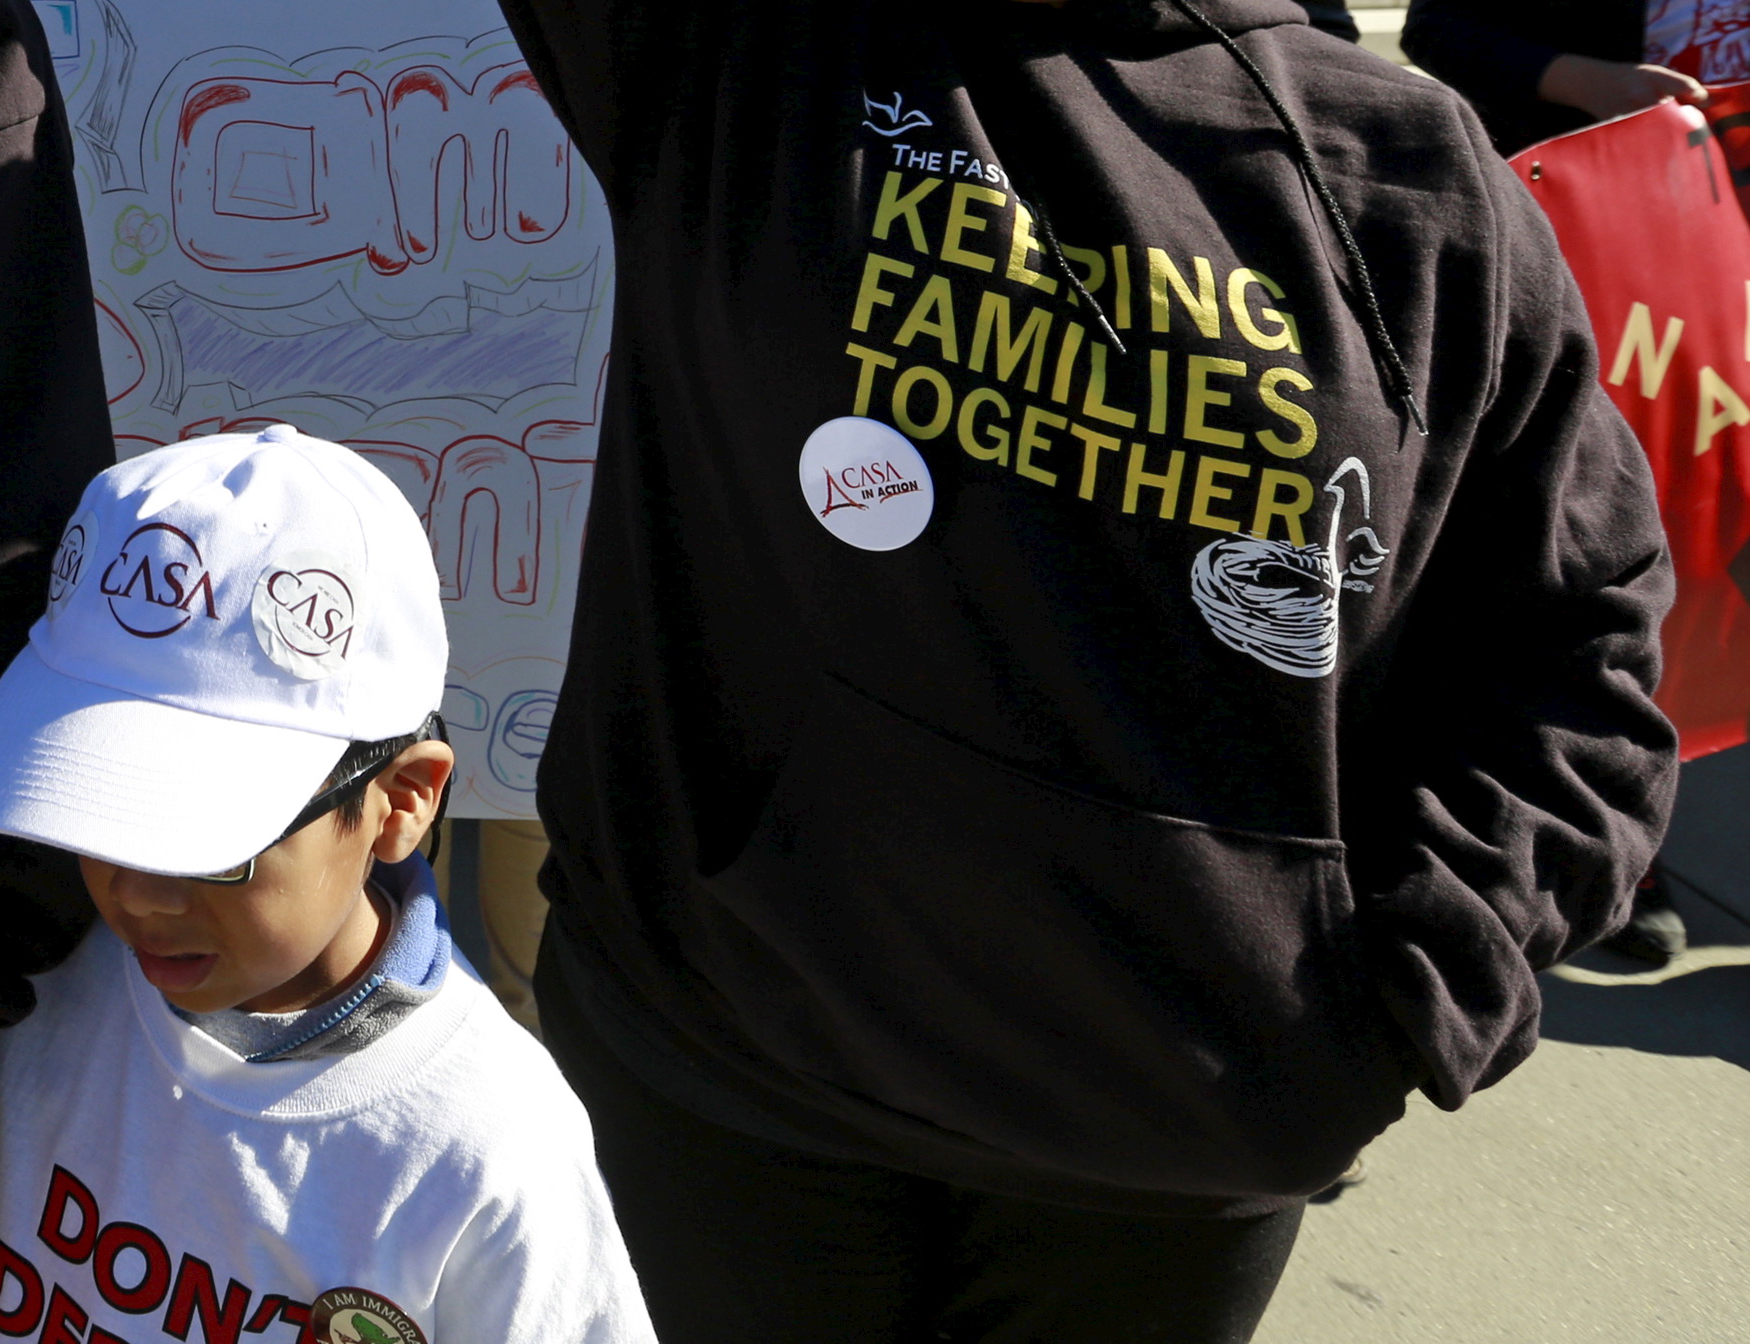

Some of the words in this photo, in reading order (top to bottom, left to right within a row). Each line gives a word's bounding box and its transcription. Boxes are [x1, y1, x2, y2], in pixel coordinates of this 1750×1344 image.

[892, 143, 943, 172] THE
[871, 170, 1303, 356] KEEPING
[850, 250, 1318, 461] FAMILIES
[841, 460, 905, 489] CASA
[845, 340, 1315, 548] TOGETHER
[861, 488, 875, 500] IN
[877, 480, 919, 498] ACTION
[99, 551, 222, 622] CASA
[266, 570, 355, 662] CASA
[334, 1292, 357, 1306] AM
